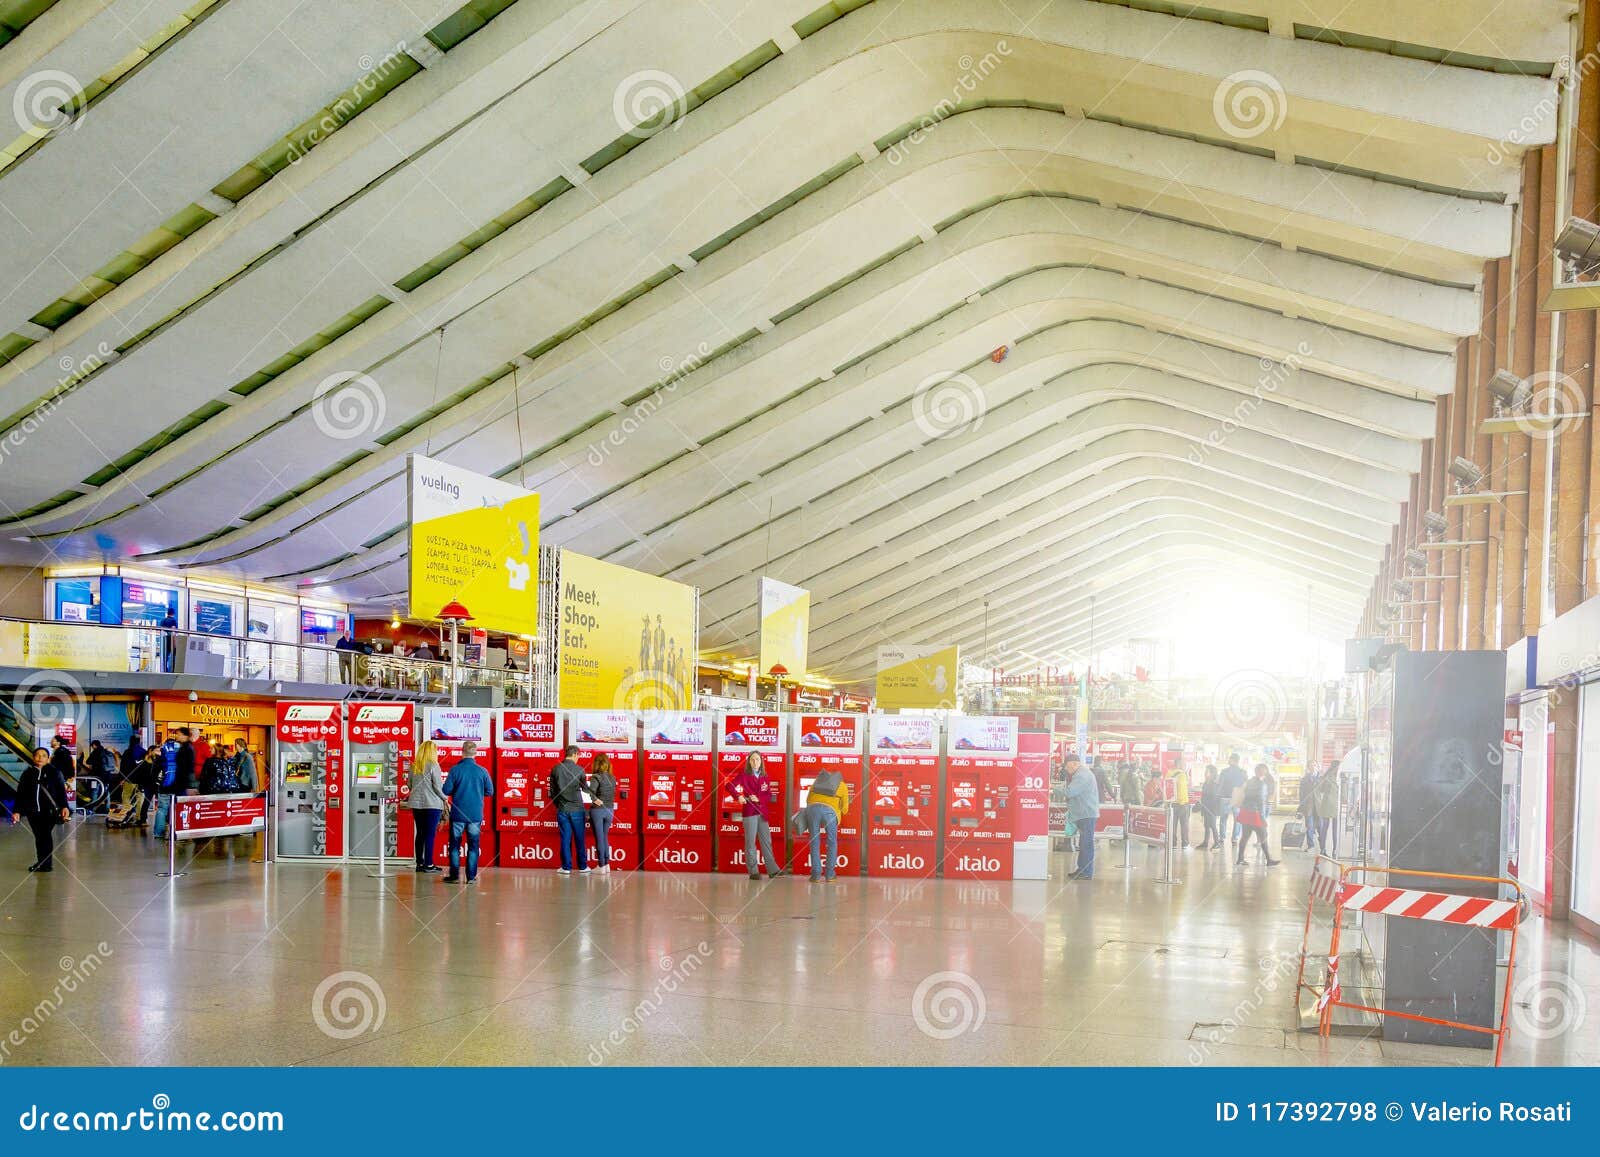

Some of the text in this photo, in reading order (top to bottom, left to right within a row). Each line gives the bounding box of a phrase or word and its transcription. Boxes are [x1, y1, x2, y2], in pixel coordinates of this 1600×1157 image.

[421, 475, 460, 499] vueling
[565, 582, 600, 606] Meet.
[564, 605, 600, 632] Shop.
[564, 629, 588, 649] Eat.
[564, 654, 599, 669] Stazione
[292, 726, 318, 735] Biglietti
[363, 726, 389, 735] Biglietti
[1024, 777, 1043, 789] 80
